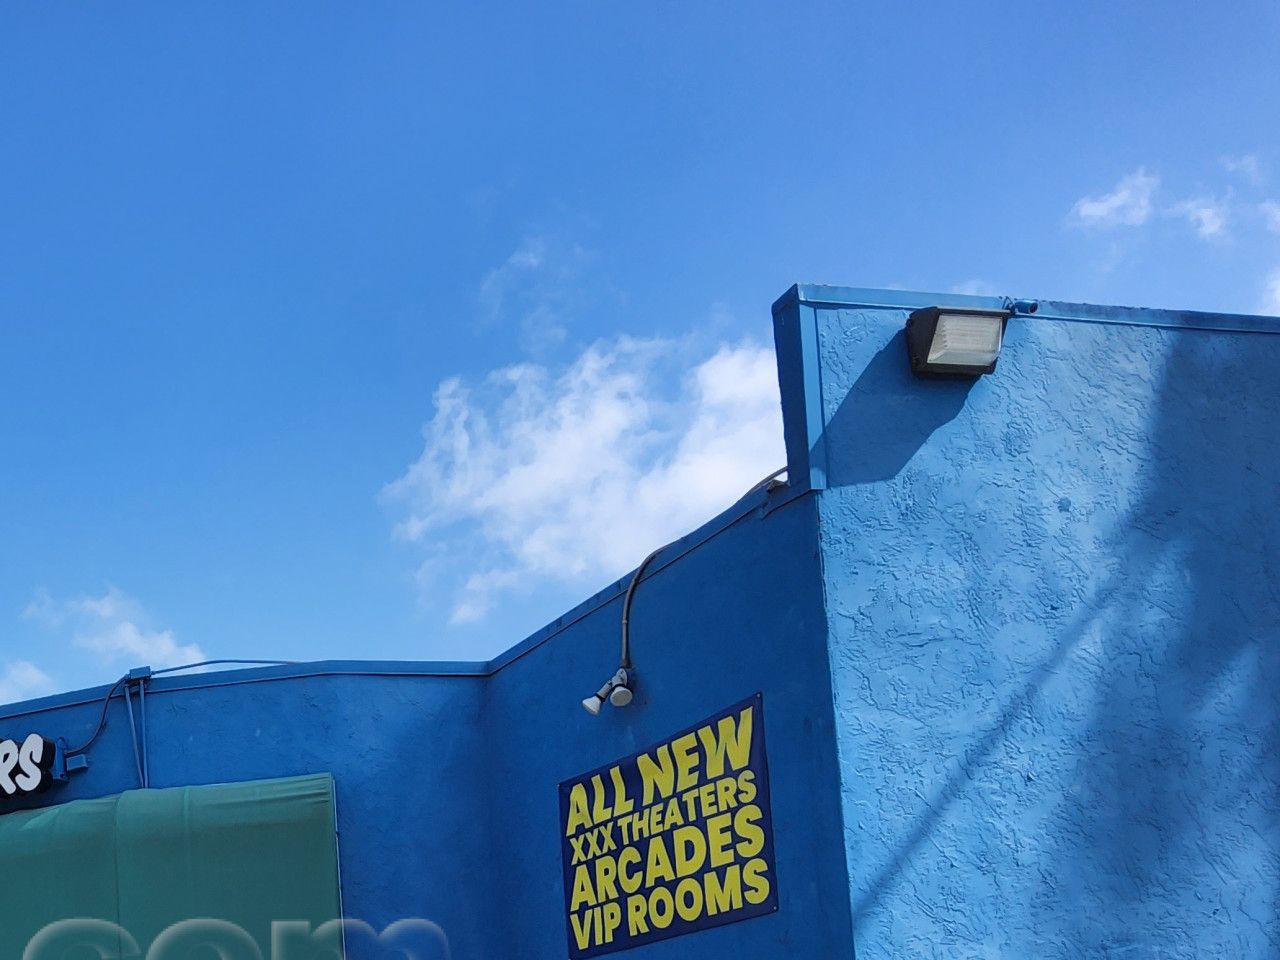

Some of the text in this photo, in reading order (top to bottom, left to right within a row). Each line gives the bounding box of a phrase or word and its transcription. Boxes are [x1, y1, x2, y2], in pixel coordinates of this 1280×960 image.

[566, 706, 753, 837] ALL NEW
[570, 769, 757, 866] XXX THEATERS
[570, 805, 765, 912] ARCADES
[570, 858, 771, 950] VIP ROOMS
